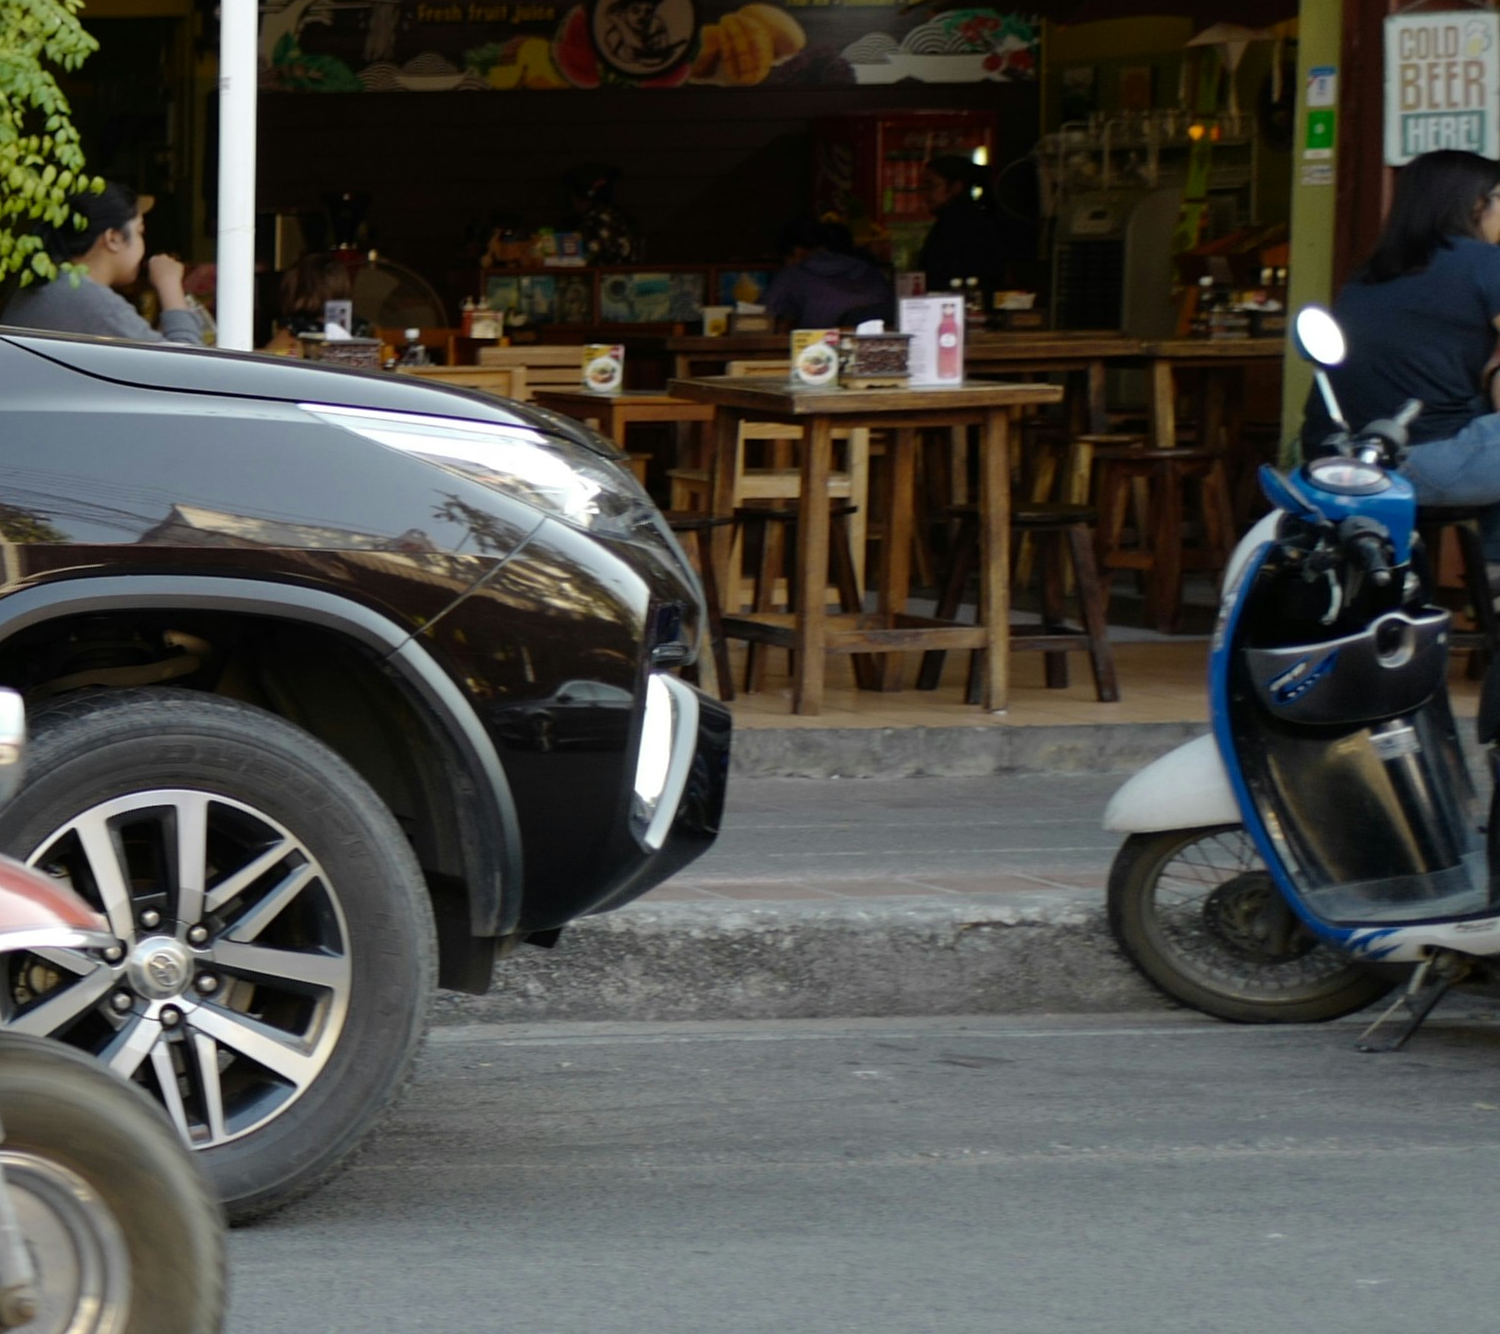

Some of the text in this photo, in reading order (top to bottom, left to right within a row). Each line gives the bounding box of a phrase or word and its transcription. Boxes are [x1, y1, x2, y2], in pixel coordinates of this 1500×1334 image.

[1400, 26, 1460, 61] COLD
[1399, 60, 1488, 112] BEER
[1405, 115, 1482, 154] HERE!
